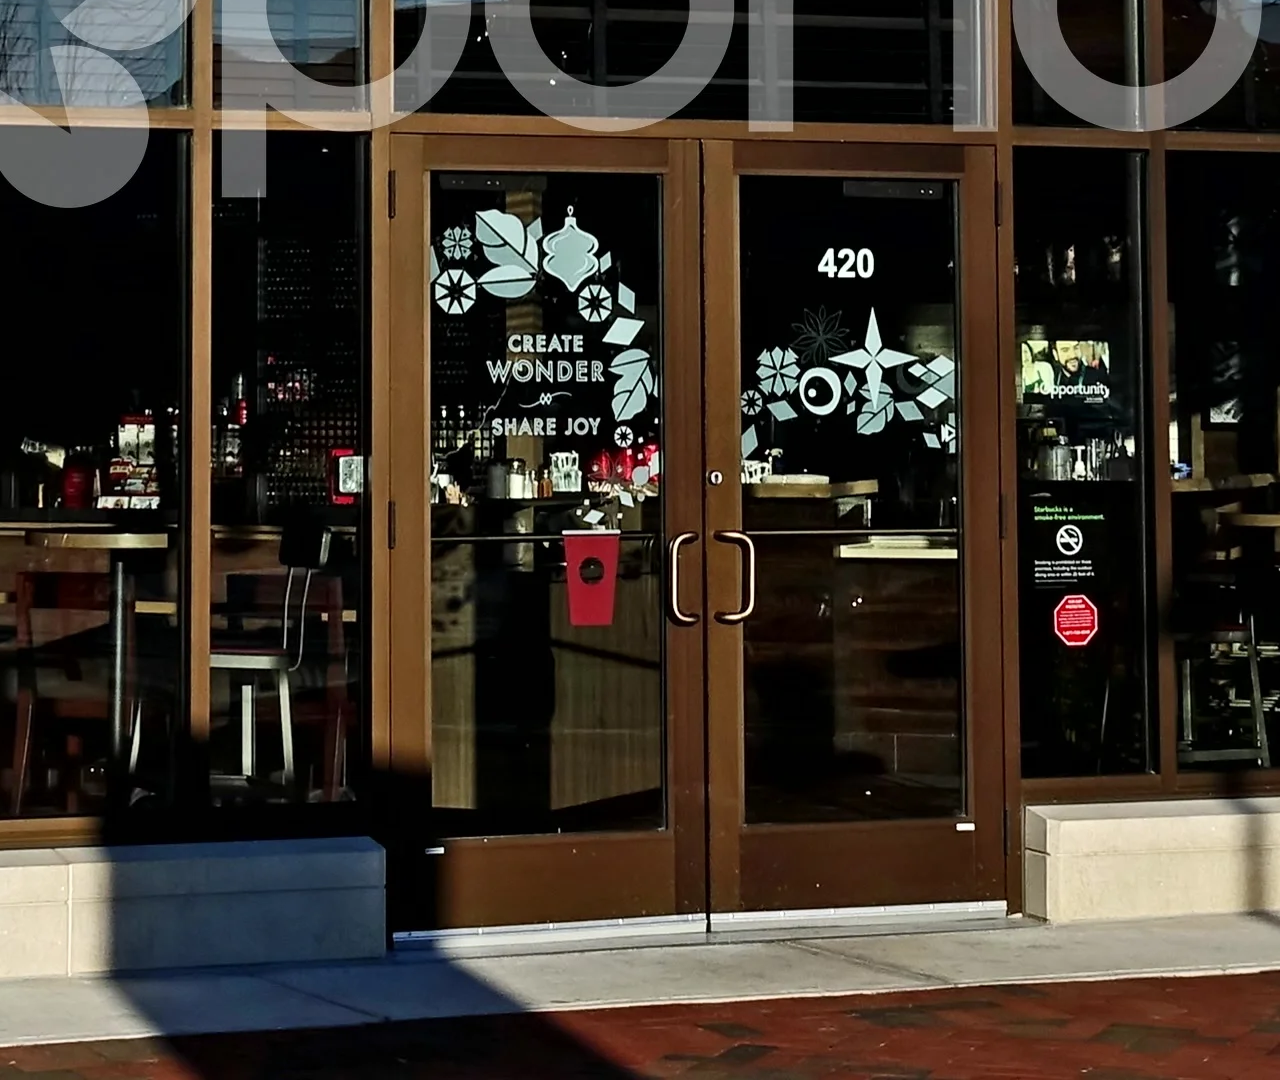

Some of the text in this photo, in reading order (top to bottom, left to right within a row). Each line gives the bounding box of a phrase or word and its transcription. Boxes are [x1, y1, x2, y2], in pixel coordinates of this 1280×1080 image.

[818, 248, 875, 279] 420
[507, 333, 584, 353] CREATE
[486, 359, 605, 384] WONDER
[1040, 381, 1110, 400] Opportunity
[491, 417, 602, 437] SHARE JOY
